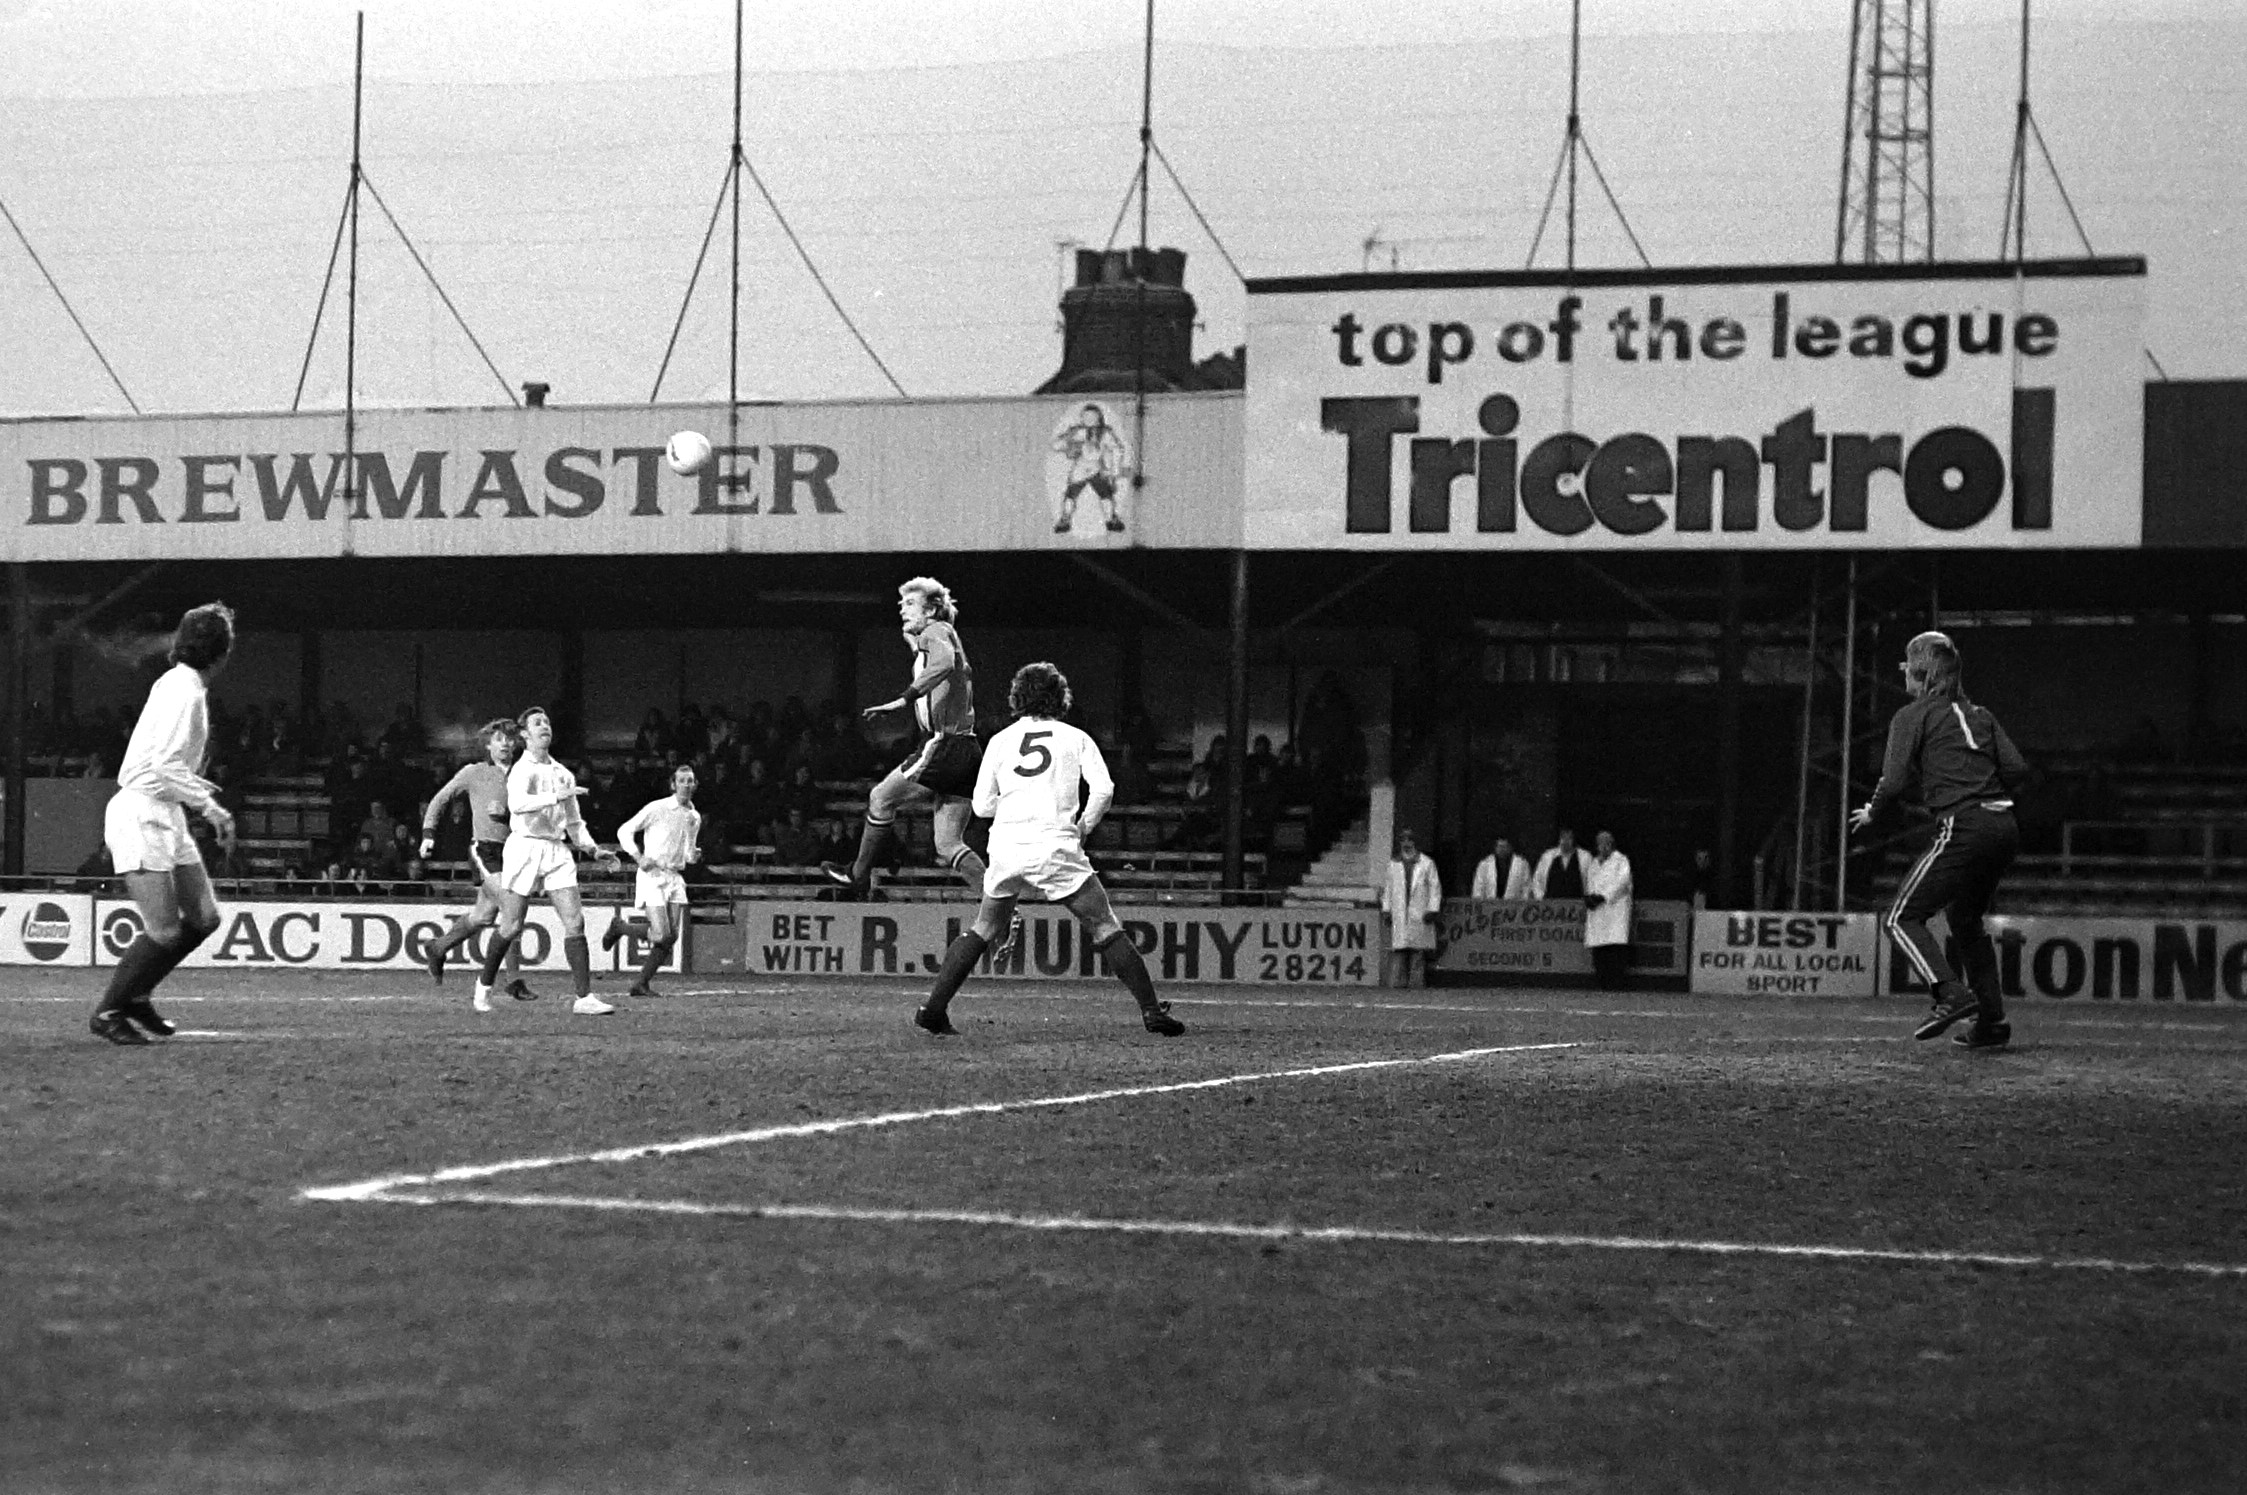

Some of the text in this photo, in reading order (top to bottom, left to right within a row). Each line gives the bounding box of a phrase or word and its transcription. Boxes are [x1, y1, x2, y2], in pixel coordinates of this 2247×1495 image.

[1333, 291, 2060, 384] top of the league
[1320, 386, 2056, 537] Tricentrol
[25, 443, 846, 526] BREWMASTER
[1013, 730, 1054, 778] 5
[212, 911, 320, 963] AC
[773, 914, 835, 940] BET
[1262, 922, 1367, 950] LUTON
[1726, 916, 1846, 950] BEST
[762, 945, 844, 972] WITH
[1260, 954, 1367, 982] 28214
[1700, 951, 1866, 973] FOR ALL LOCAL
[1747, 975, 1821, 993] SPORT
